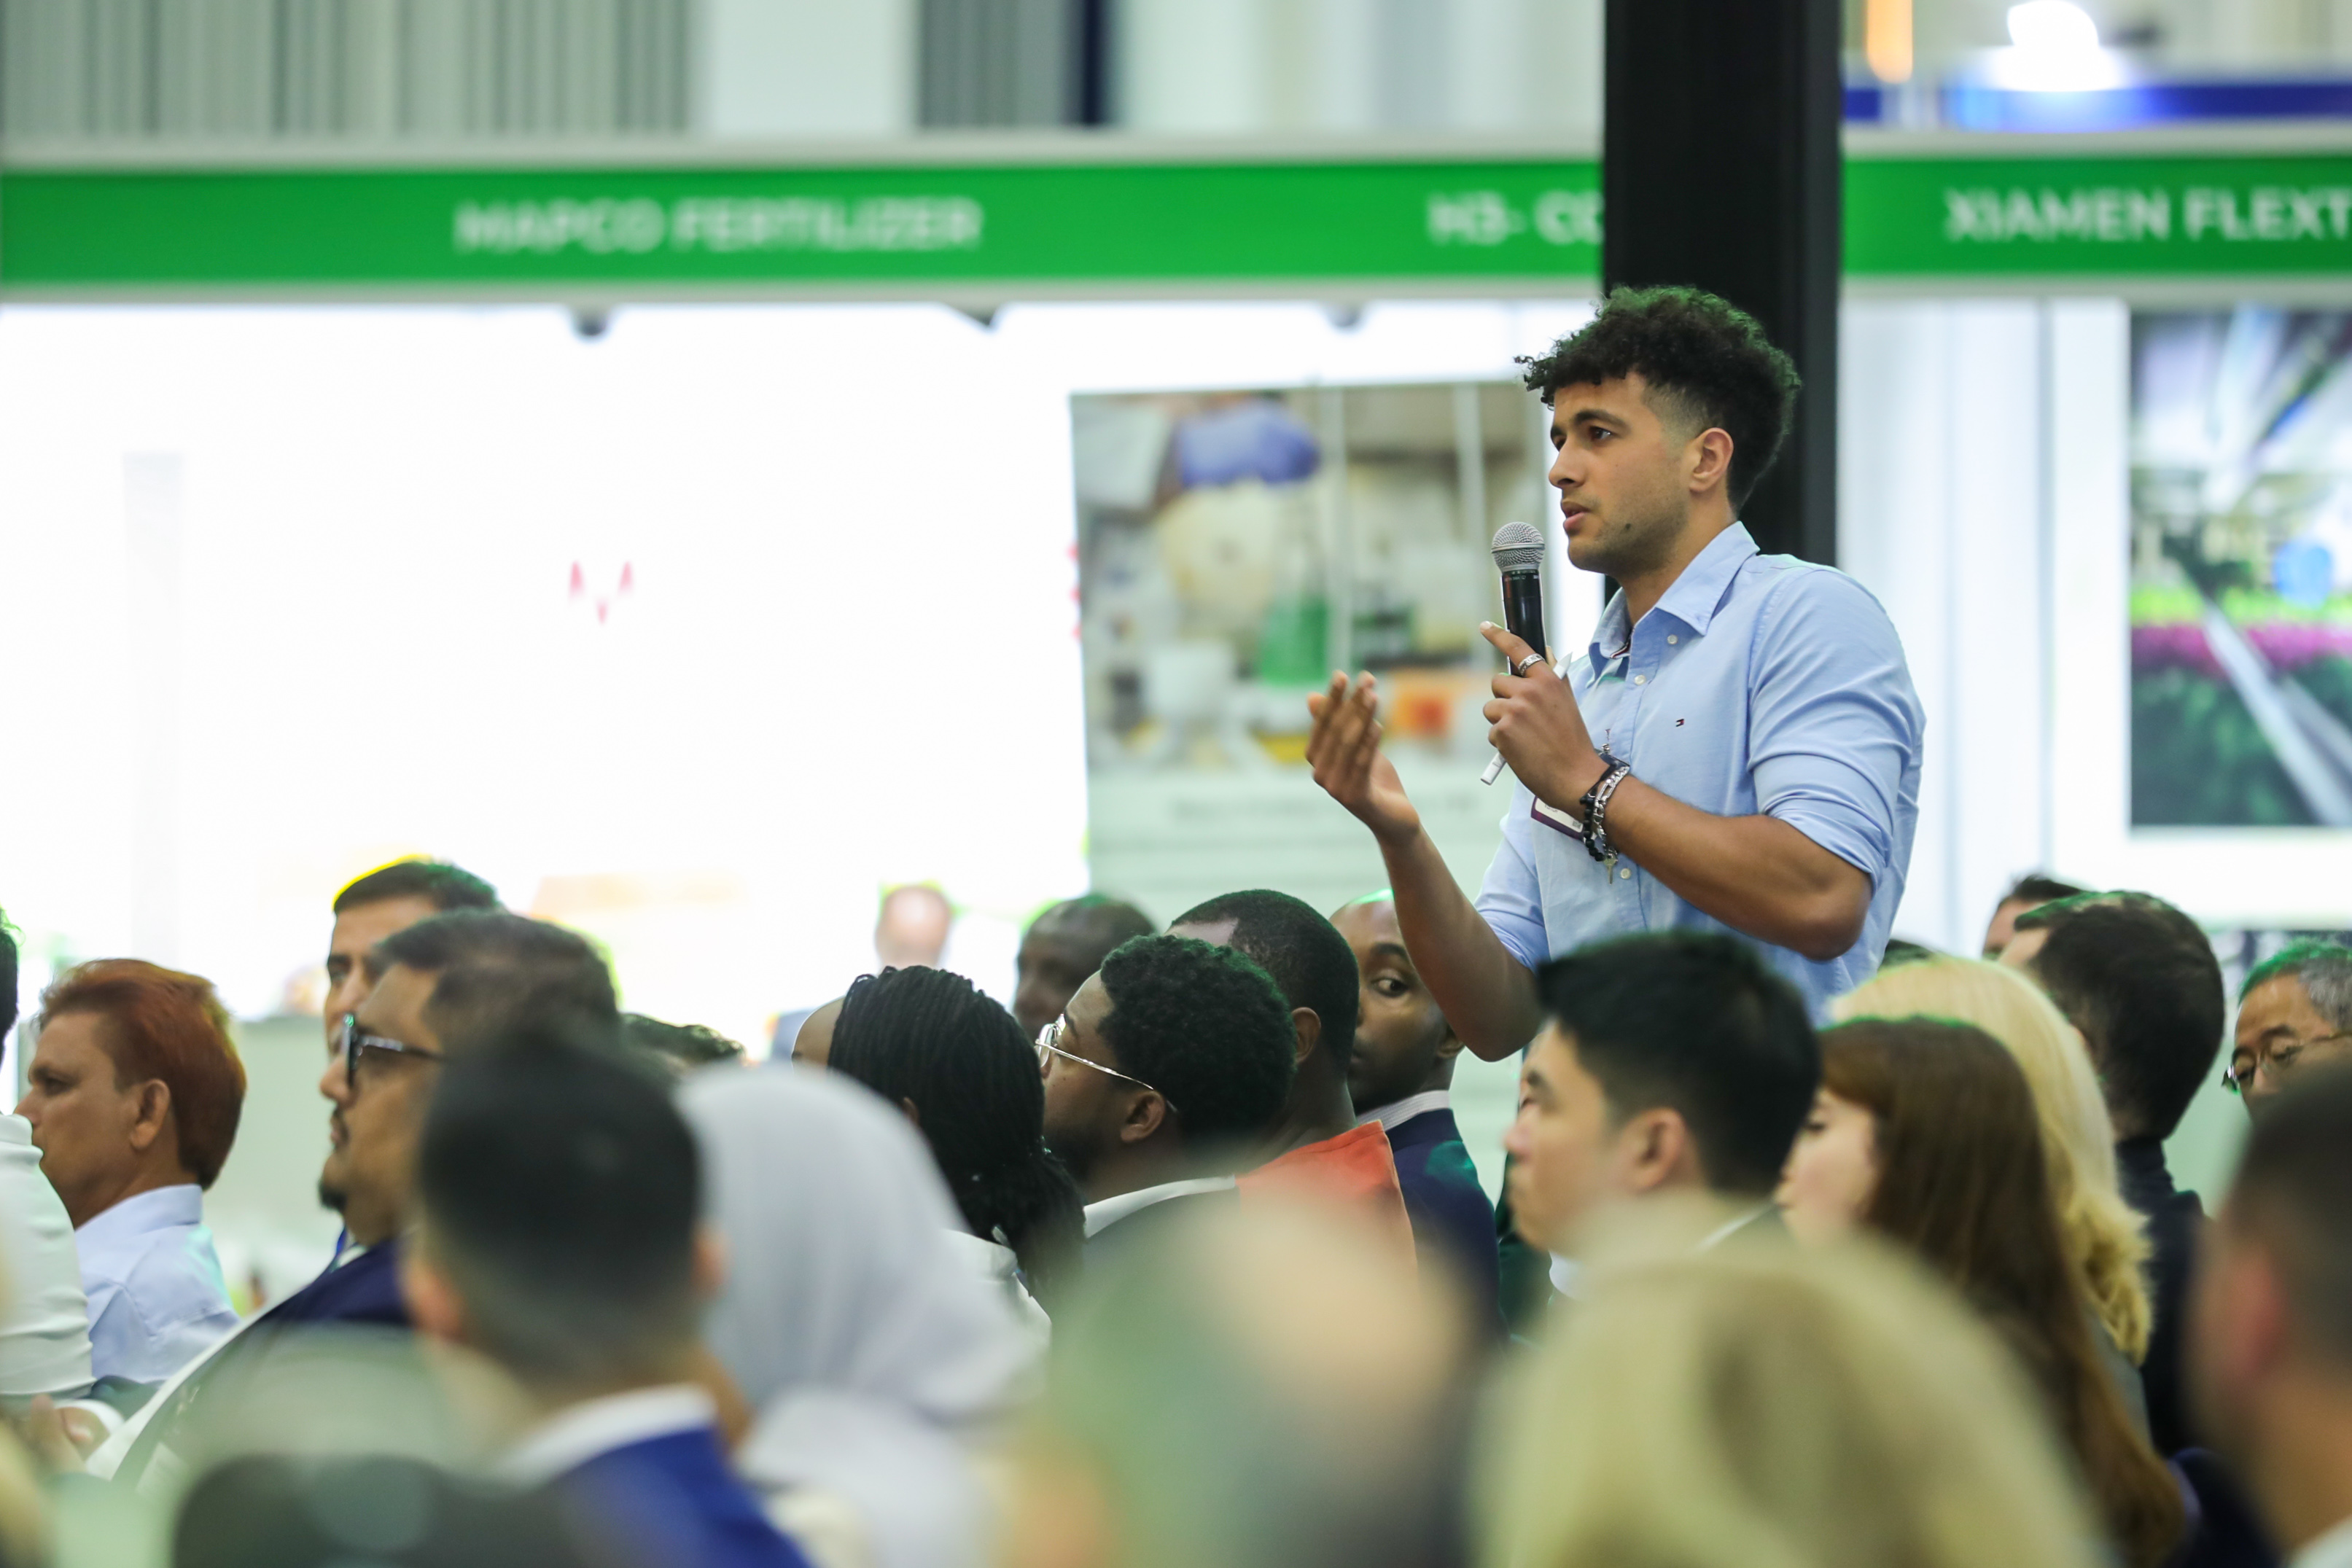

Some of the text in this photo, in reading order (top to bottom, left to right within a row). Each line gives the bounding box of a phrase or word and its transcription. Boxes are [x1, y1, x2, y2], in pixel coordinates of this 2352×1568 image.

[455, 195, 984, 254] MAPCO FERTILIZER
[1944, 185, 2352, 242] XIAMEN FLEXT
